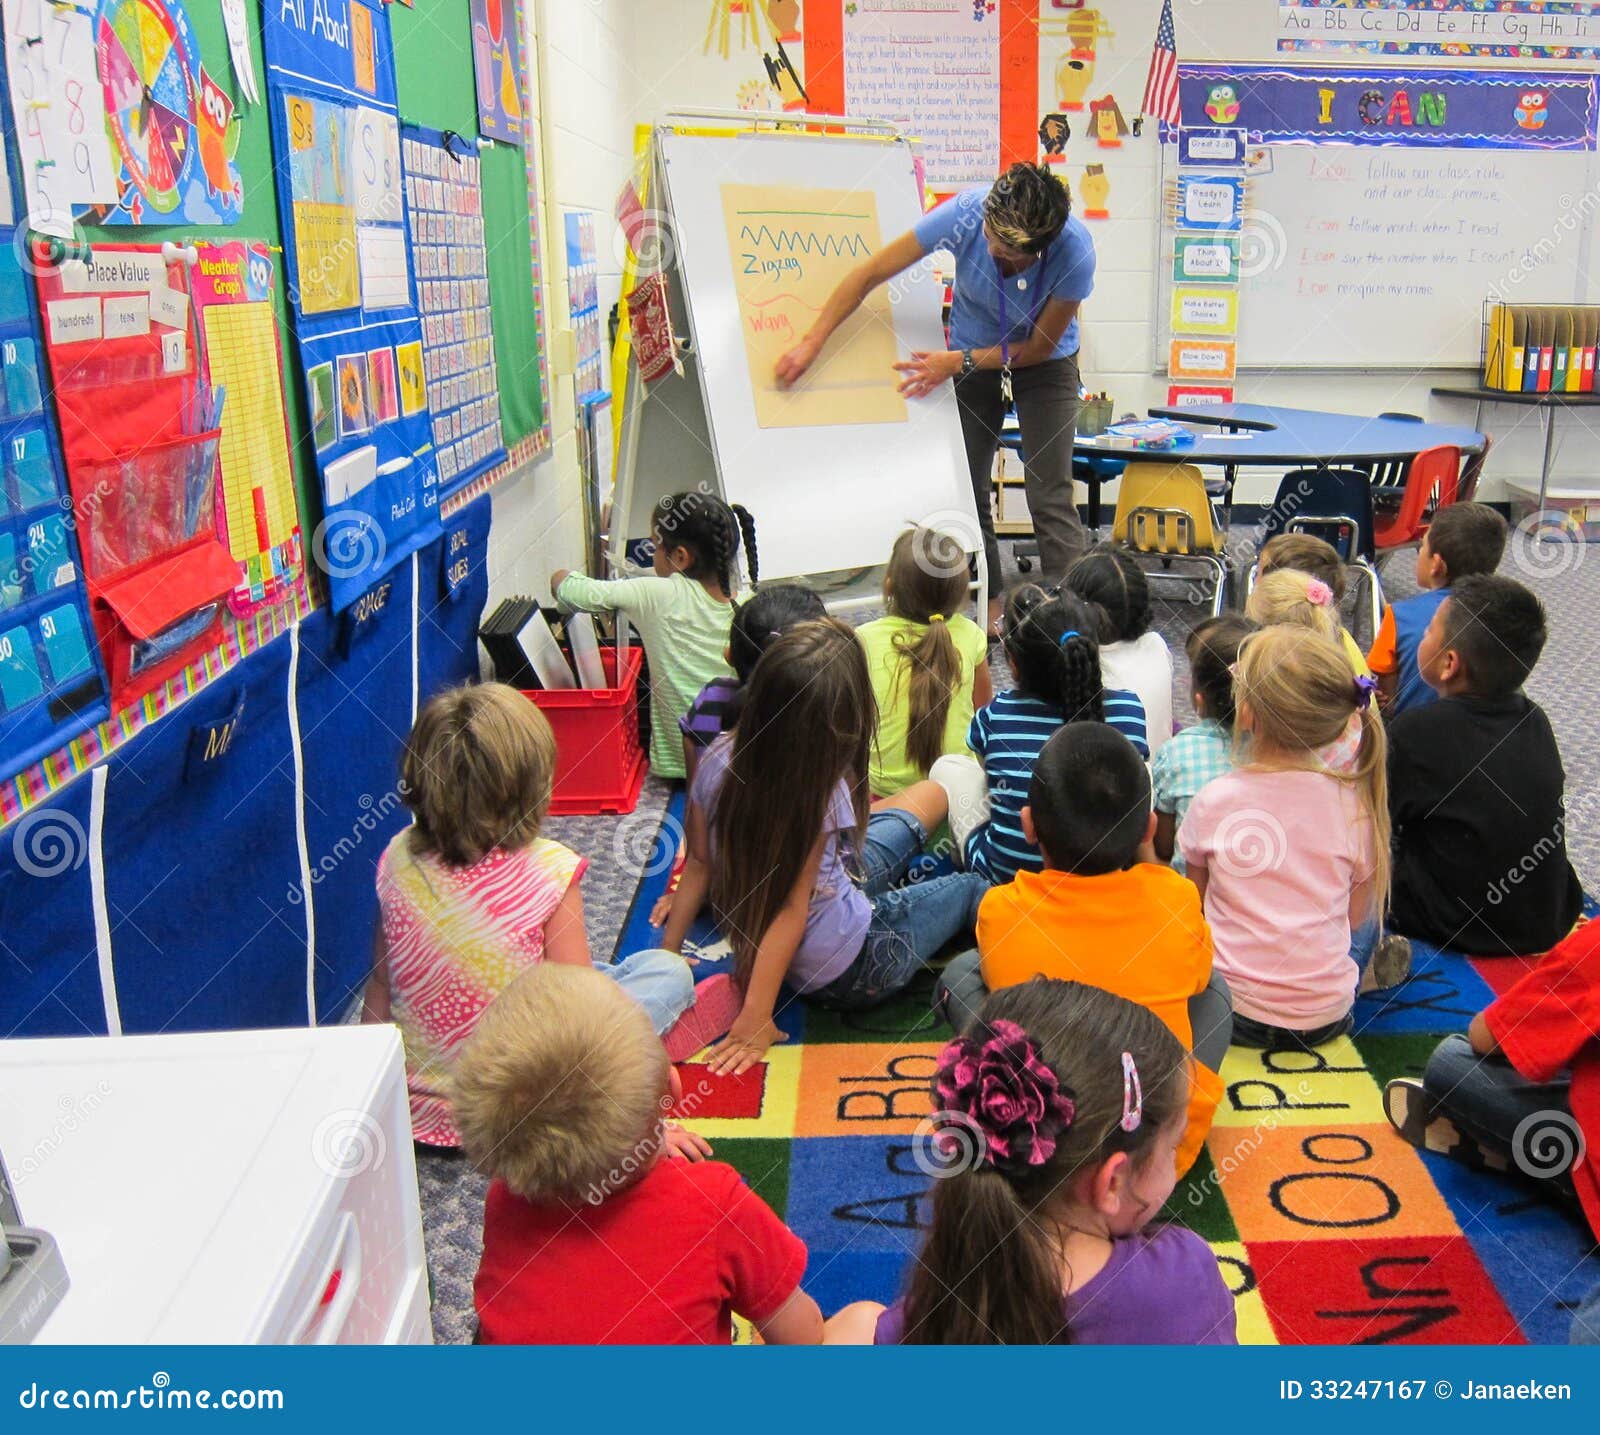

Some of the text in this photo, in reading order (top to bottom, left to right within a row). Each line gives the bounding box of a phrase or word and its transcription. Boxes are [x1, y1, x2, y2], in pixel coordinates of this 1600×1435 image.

[282, 0, 306, 30] All
[312, 0, 349, 49] About
[65, 79, 84, 134] 8
[1318, 88, 1447, 127] I CAN
[1364, 184, 1387, 199] and
[87, 261, 150, 283] Place Value
[200, 259, 240, 276] Weather
[740, 253, 803, 282] Zigzag
[213, 279, 241, 297] Graph
[58, 312, 95, 329] hundreds
[120, 312, 135, 324] tens
[748, 310, 795, 343] Wavy
[5, 343, 17, 364] 10
[13, 438, 26, 460] 17
[29, 523, 46, 549] 24
[40, 615, 56, 639] 31
[837, 1054, 938, 1121] Bb
[1269, 1133, 1401, 1228] Oo
